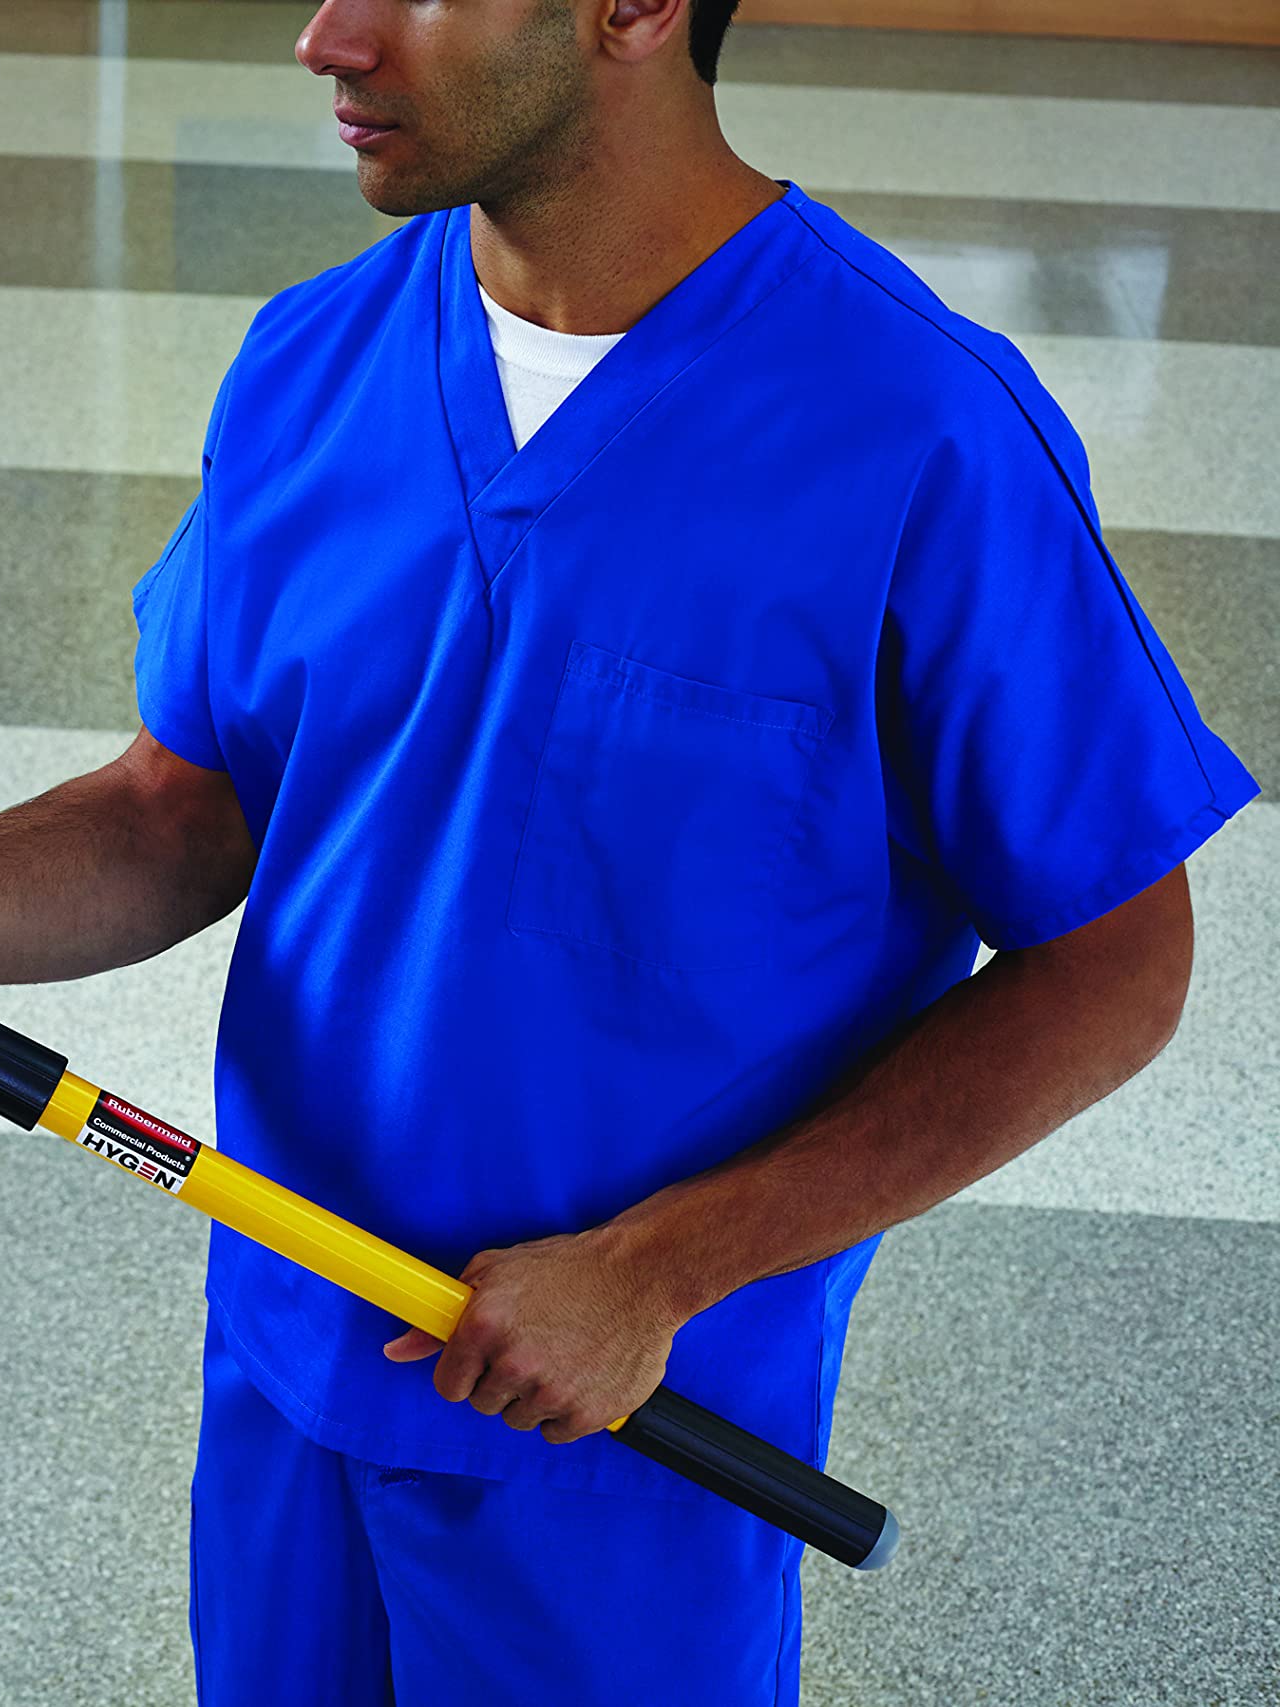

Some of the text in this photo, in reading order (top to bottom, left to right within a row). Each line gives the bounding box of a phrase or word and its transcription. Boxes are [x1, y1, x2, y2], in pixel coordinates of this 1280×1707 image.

[93, 1117, 186, 1172] Commercial Products
[108, 1098, 192, 1148] Rubbermaid
[82, 1132, 177, 1190] HYGEN
